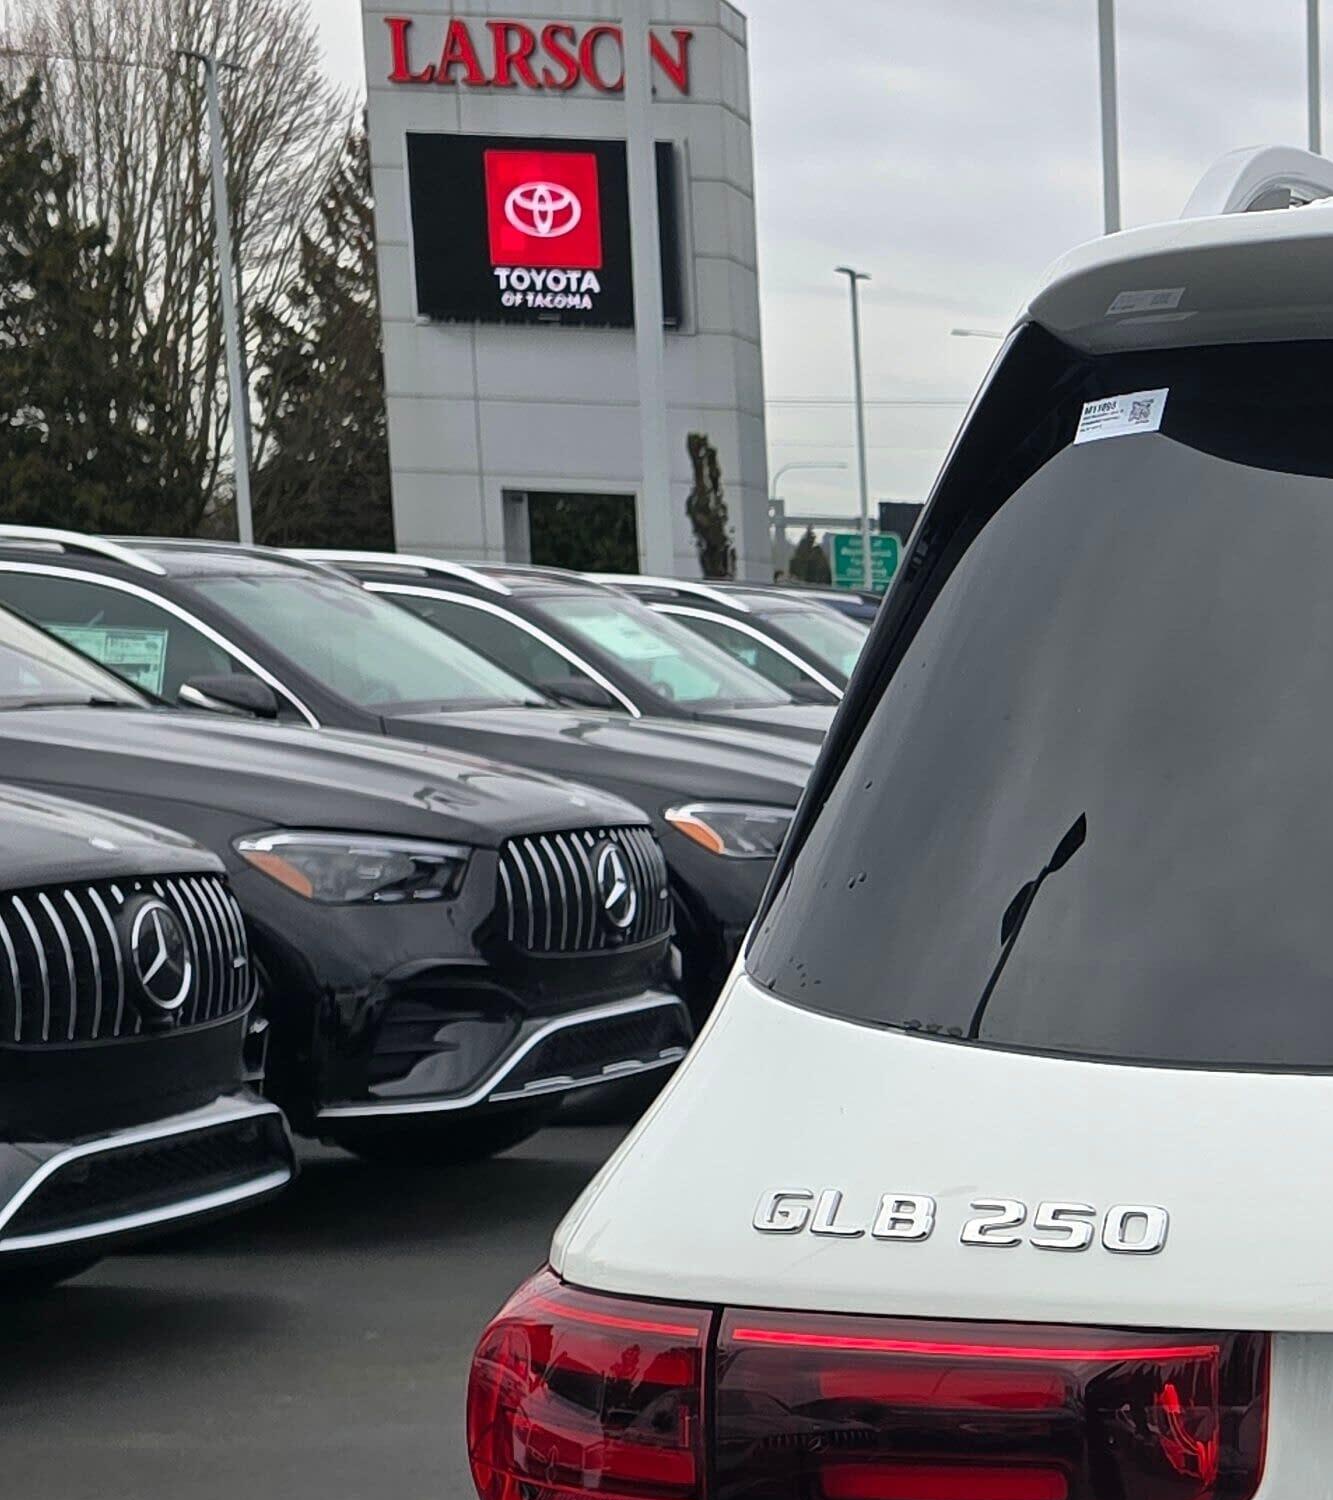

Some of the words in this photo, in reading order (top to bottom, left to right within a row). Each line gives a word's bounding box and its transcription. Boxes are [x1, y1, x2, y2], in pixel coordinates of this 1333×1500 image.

[493, 266, 601, 294] TOYOTA
[501, 290, 524, 307] OF
[526, 291, 593, 310] TACOMA
[752, 1187, 937, 1242] GLB
[959, 1198, 1171, 1256] 250
